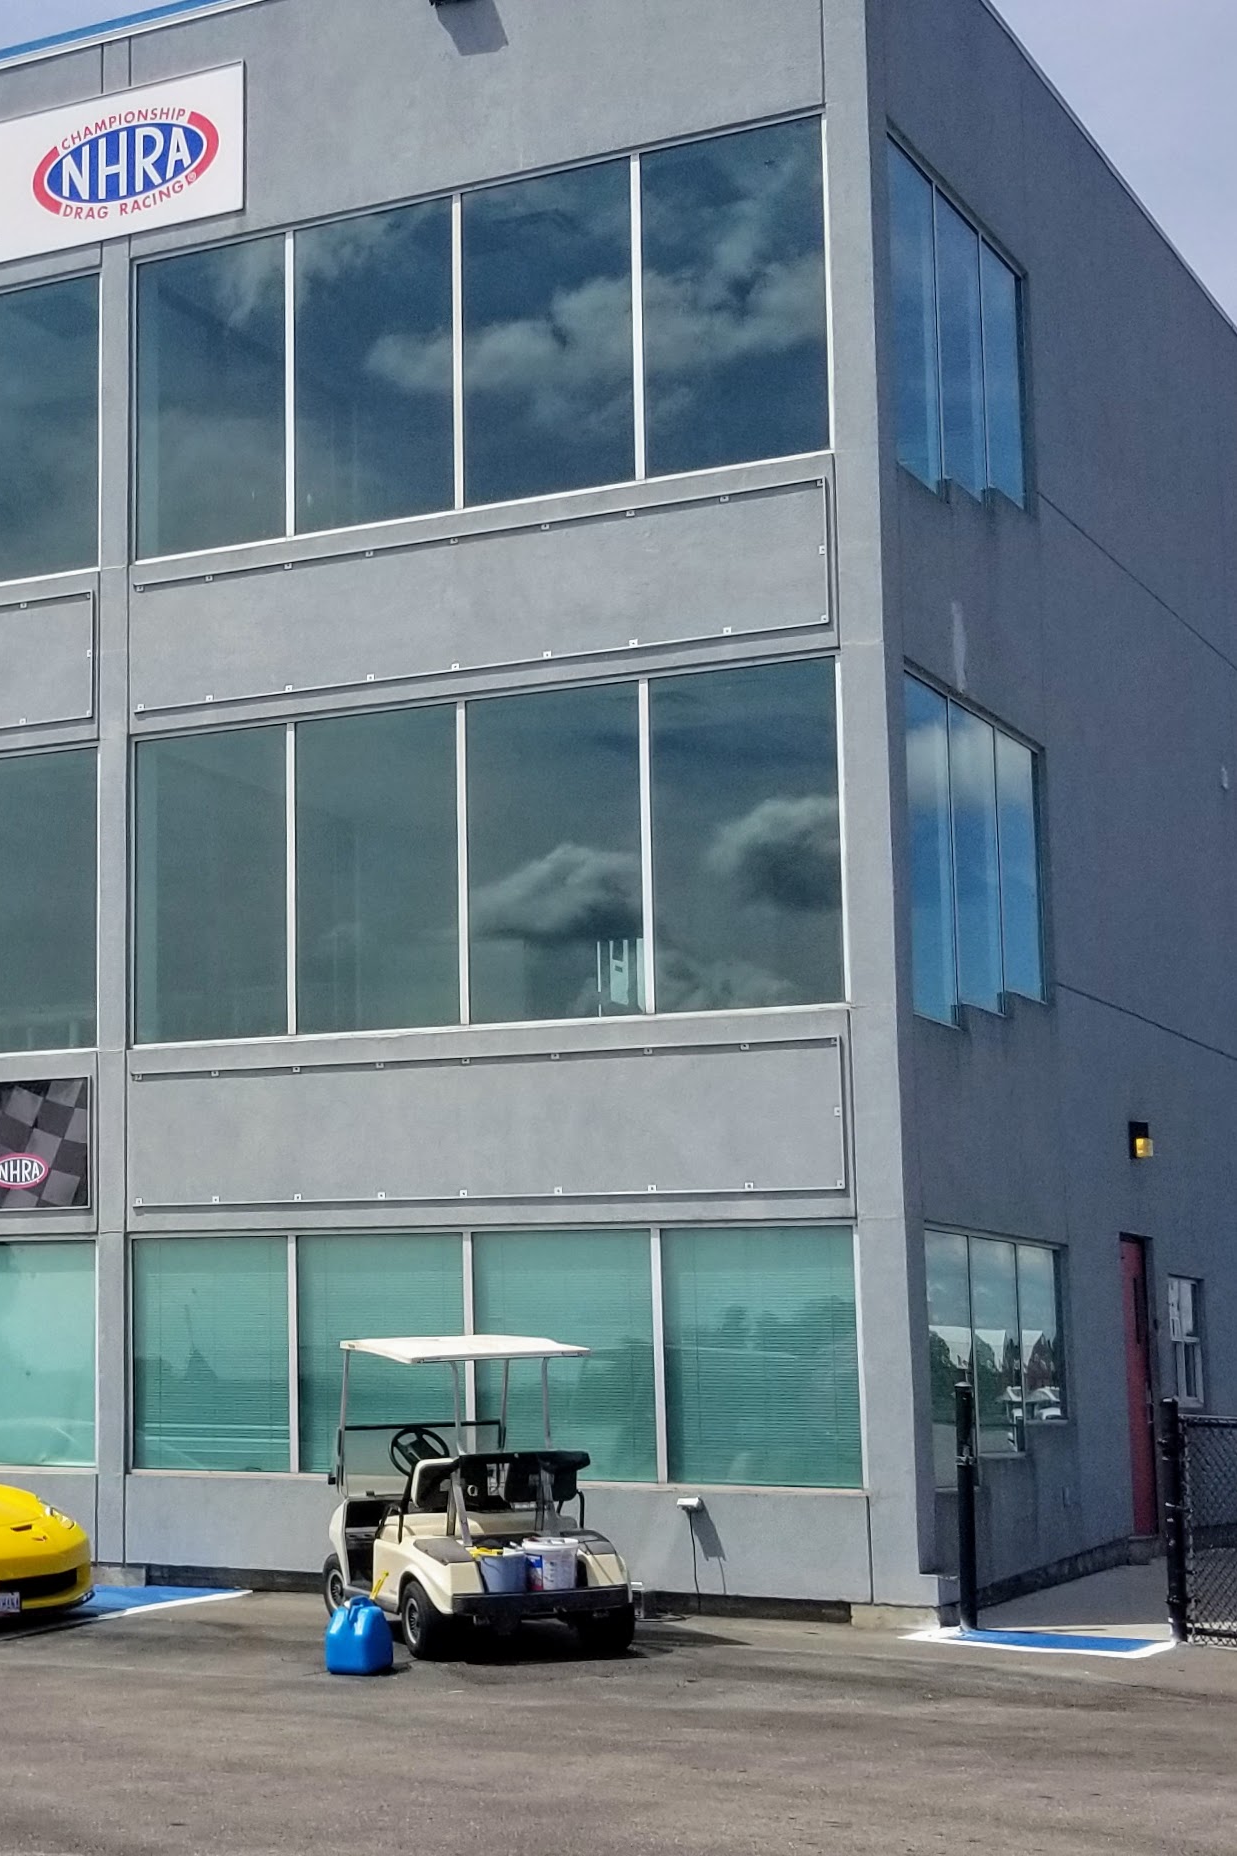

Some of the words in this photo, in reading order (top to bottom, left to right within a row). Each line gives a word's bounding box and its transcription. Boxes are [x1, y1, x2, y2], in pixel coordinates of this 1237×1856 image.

[61, 107, 186, 150] CHAMPIONSHIP
[62, 126, 192, 200] NHRA
[63, 204, 109, 220] DRAG
[119, 180, 184, 216] RACING
